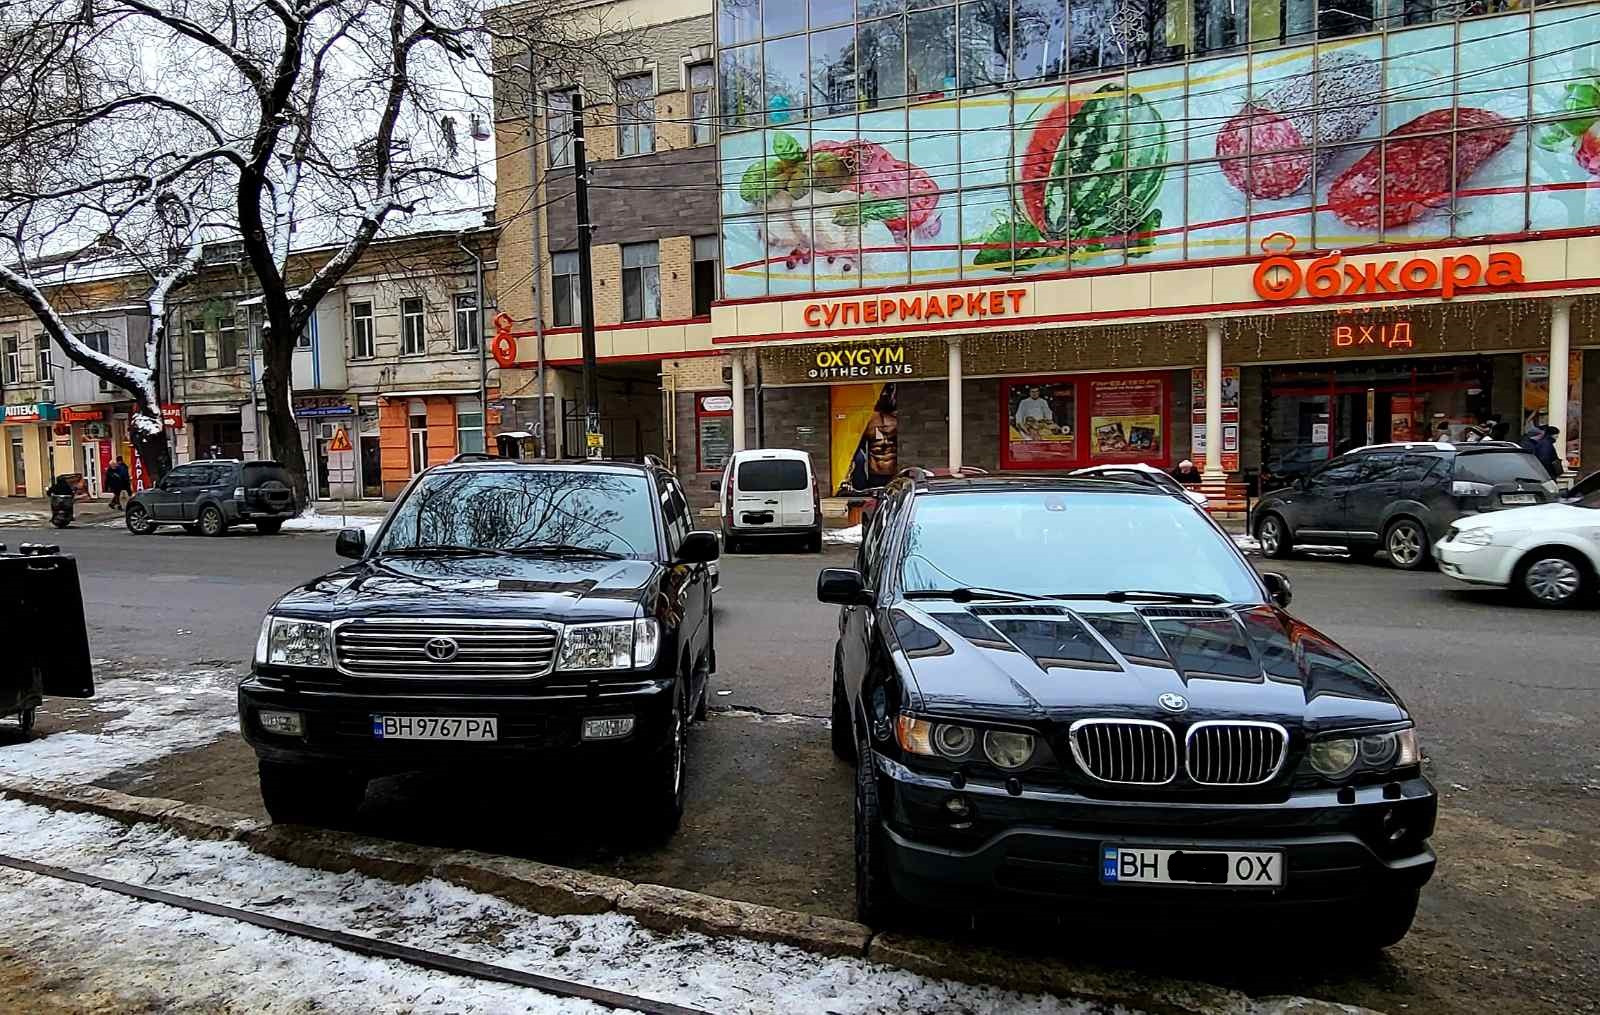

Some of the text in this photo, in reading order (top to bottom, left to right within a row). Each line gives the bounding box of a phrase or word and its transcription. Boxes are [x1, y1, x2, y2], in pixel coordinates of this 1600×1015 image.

[1253, 250, 1525, 300] Обжора
[804, 289, 1026, 327] СУПЕРМАРКЕТ
[1336, 322, 1413, 348] ВХІД
[816, 347, 904, 367] OXYGYM
[808, 364, 912, 378] ФИТНЕС КЛУБ
[5, 404, 39, 416] АПТЕКА
[162, 409, 181, 417] БАРД
[1104, 867, 1116, 876] UA
